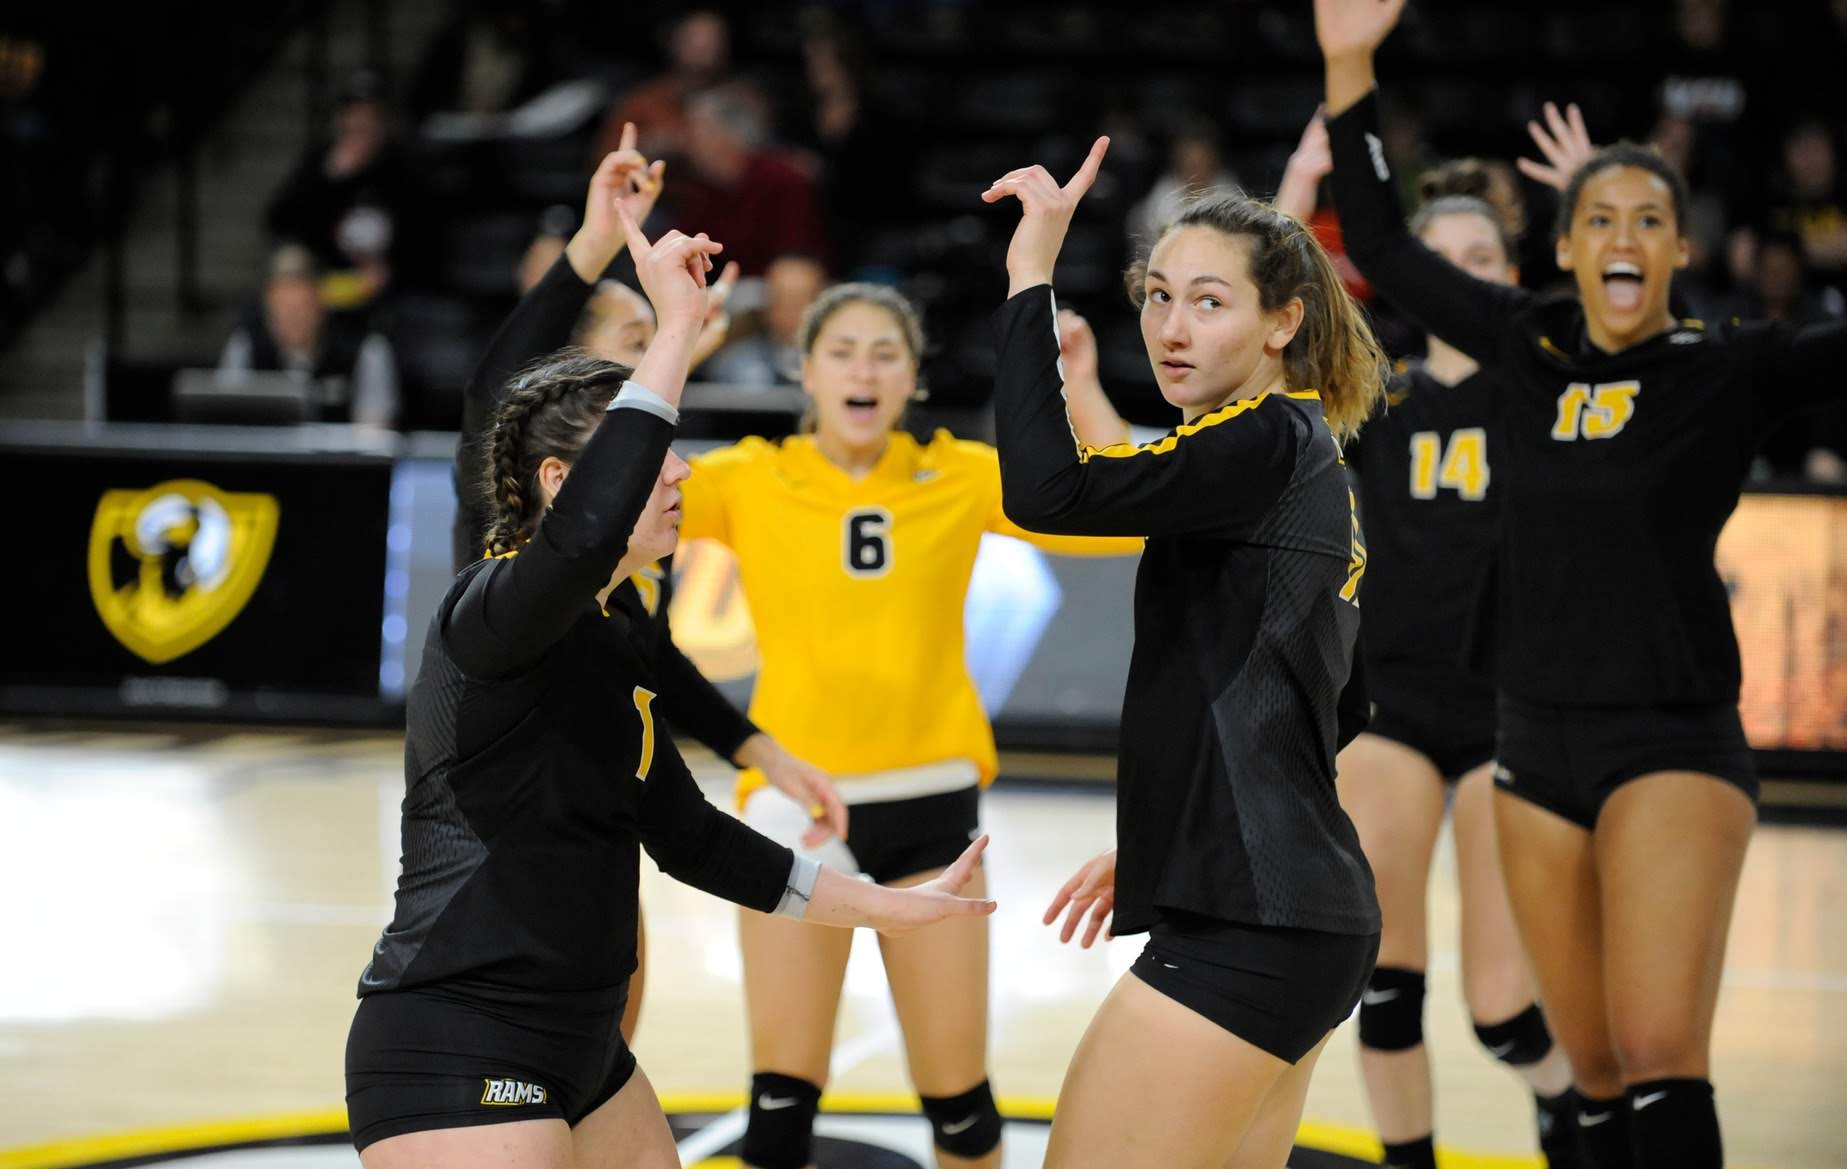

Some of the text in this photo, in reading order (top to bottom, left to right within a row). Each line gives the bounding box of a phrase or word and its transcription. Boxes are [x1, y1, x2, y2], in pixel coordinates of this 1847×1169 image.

[1551, 380, 1640, 441] 15
[1410, 427, 1490, 501] 14
[844, 508, 892, 576] 6
[482, 1079, 546, 1105] RAMS
